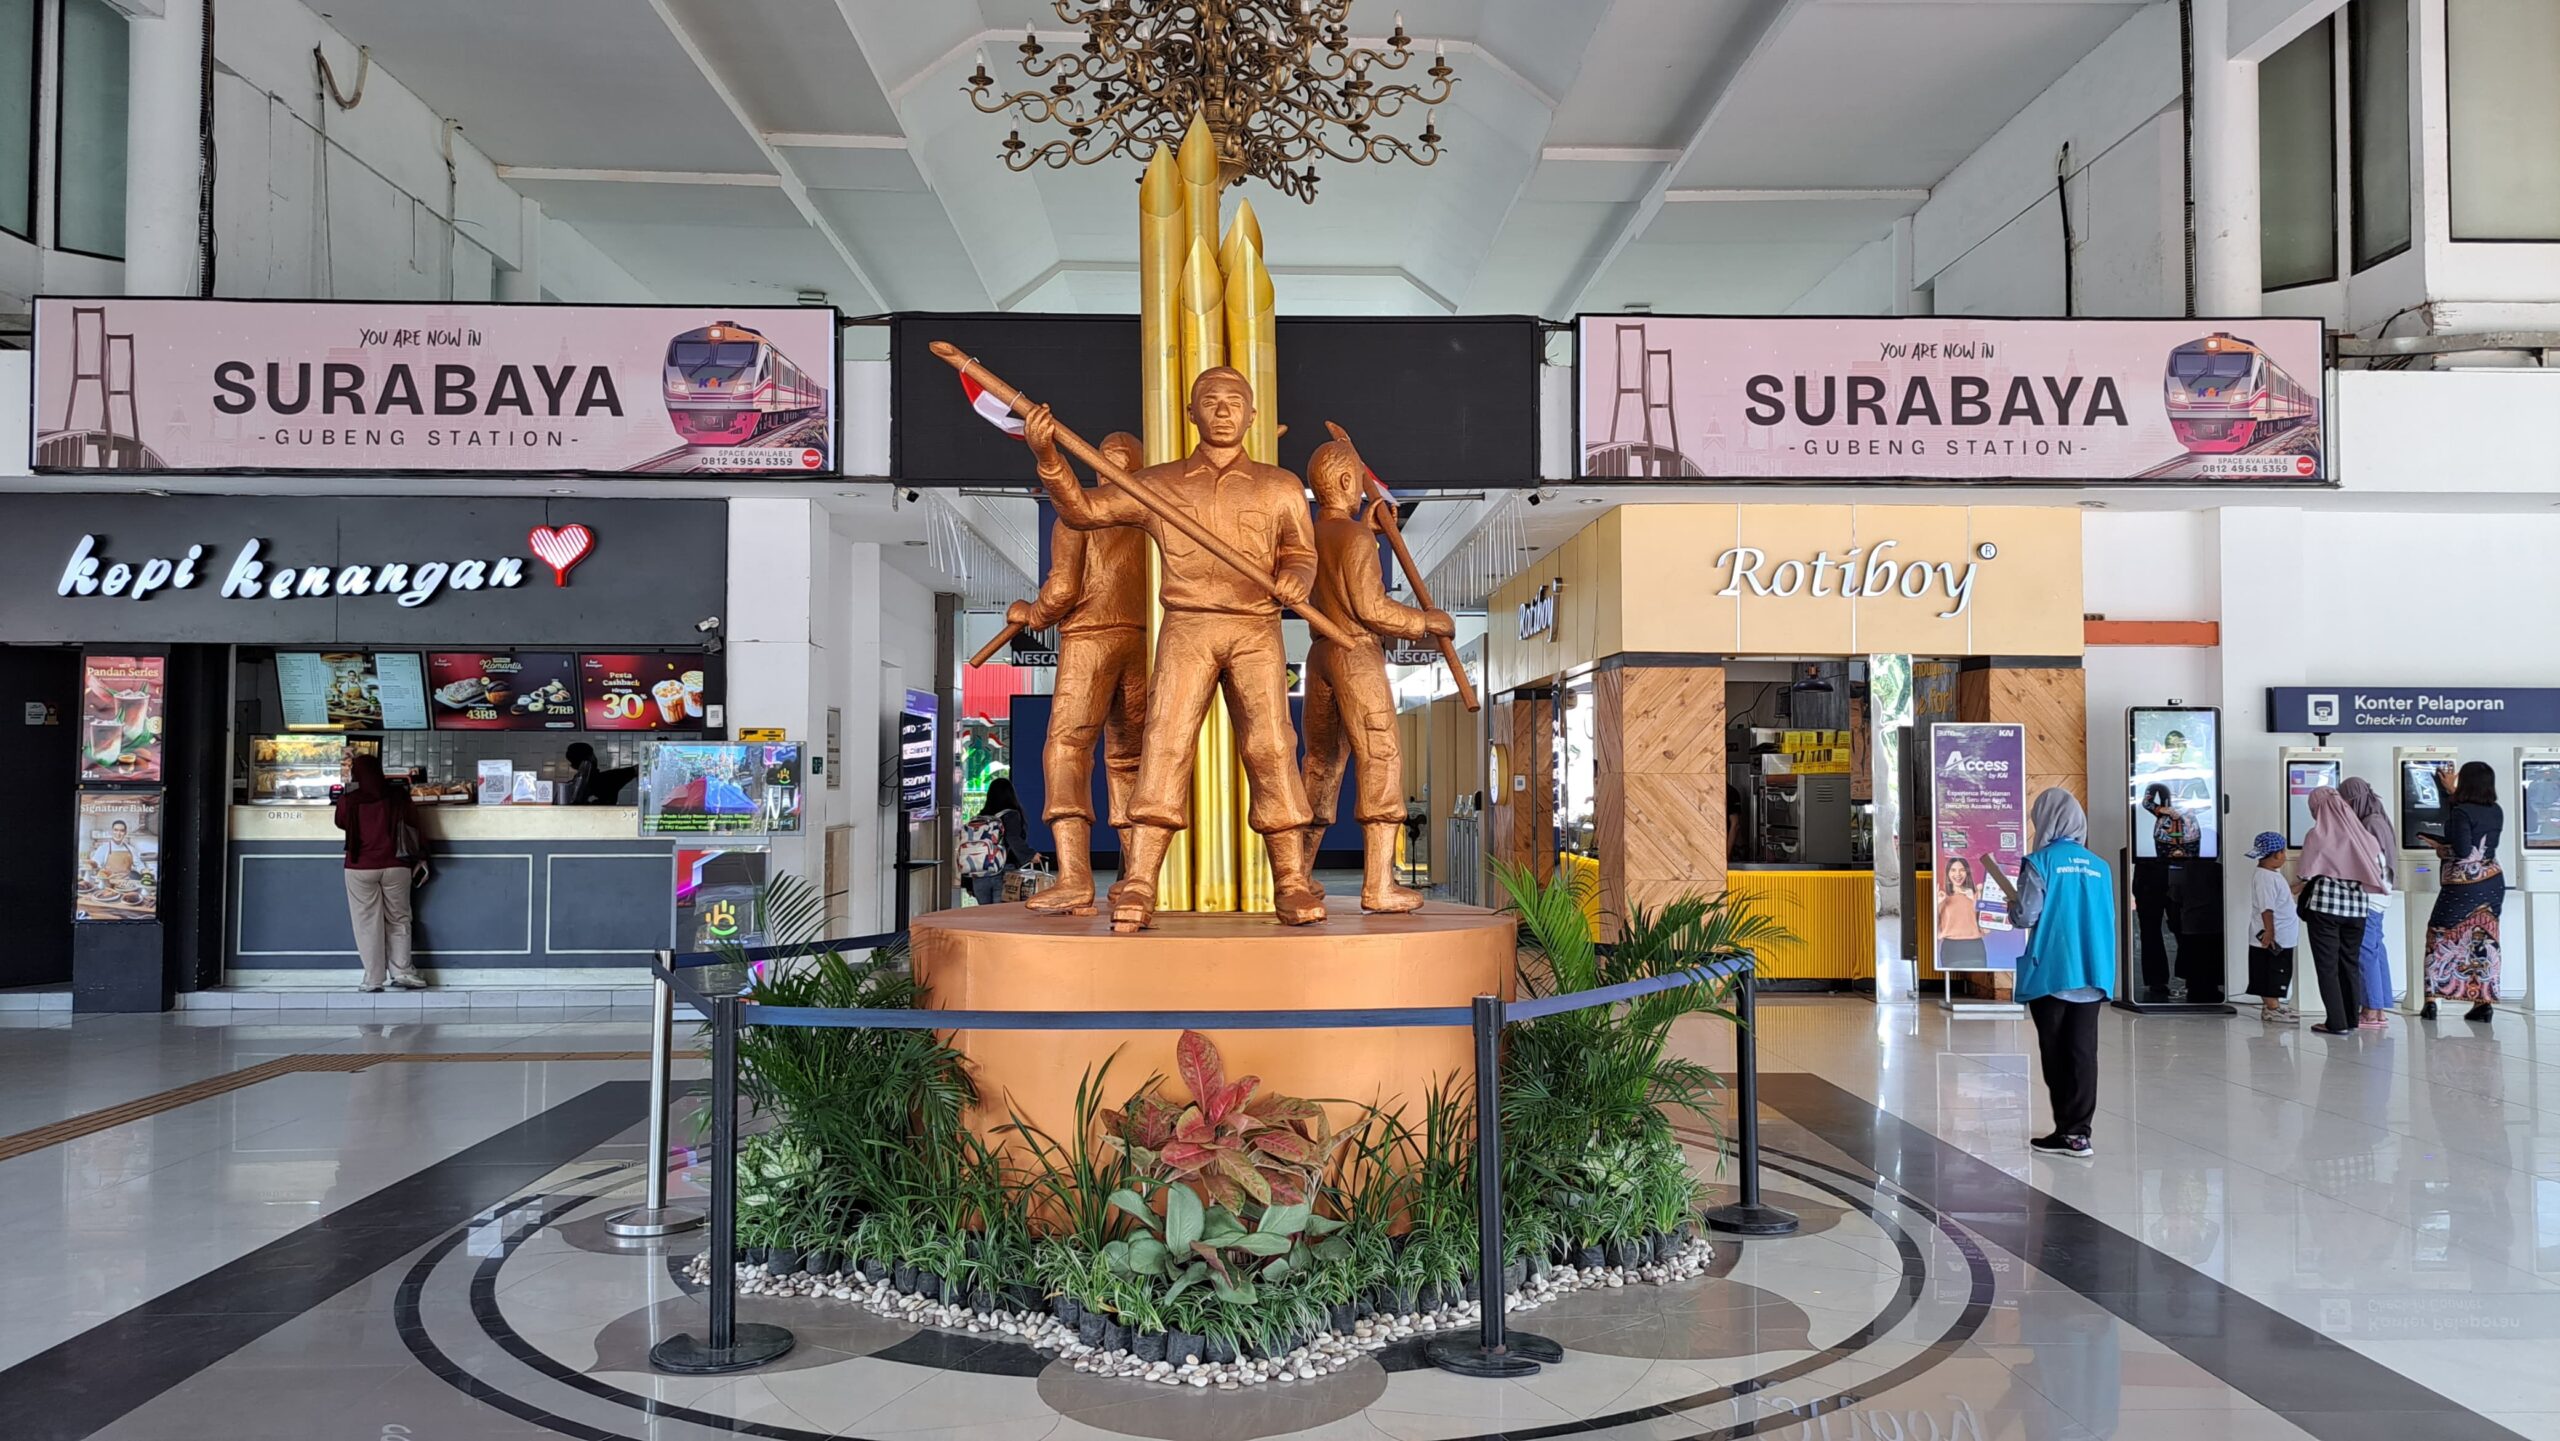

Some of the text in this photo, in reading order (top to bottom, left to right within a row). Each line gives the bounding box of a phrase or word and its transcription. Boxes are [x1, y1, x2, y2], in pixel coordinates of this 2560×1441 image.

[360, 328, 388, 348] YOU
[393, 329, 421, 347] ARE
[427, 328, 461, 346] NOW
[1881, 342, 1907, 361] YOU
[1912, 342, 1938, 360] ARE
[1943, 341, 1976, 360] NOW
[212, 360, 625, 417] SURABAYA
[1745, 374, 2129, 426] SURABAYA
[701, 457, 793, 466] 0812 4954 5359
[2202, 465, 2288, 473] 0812 4954 5359
[57, 534, 524, 608] kopi kenangan
[1714, 539, 1978, 618] Rotiboy
[1518, 585, 1555, 643] Rotiboy
[87, 667, 159, 677] Pandan Series
[2354, 695, 2505, 713] Konter Pelaporan
[466, 710, 497, 720] 43RB
[2355, 713, 2468, 726] Check-in Counter
[1944, 751, 2009, 771] Access
[1980, 790, 2011, 798] Perjalanan
[81, 804, 155, 814] Signature Bake
[268, 811, 302, 819] ORDER
